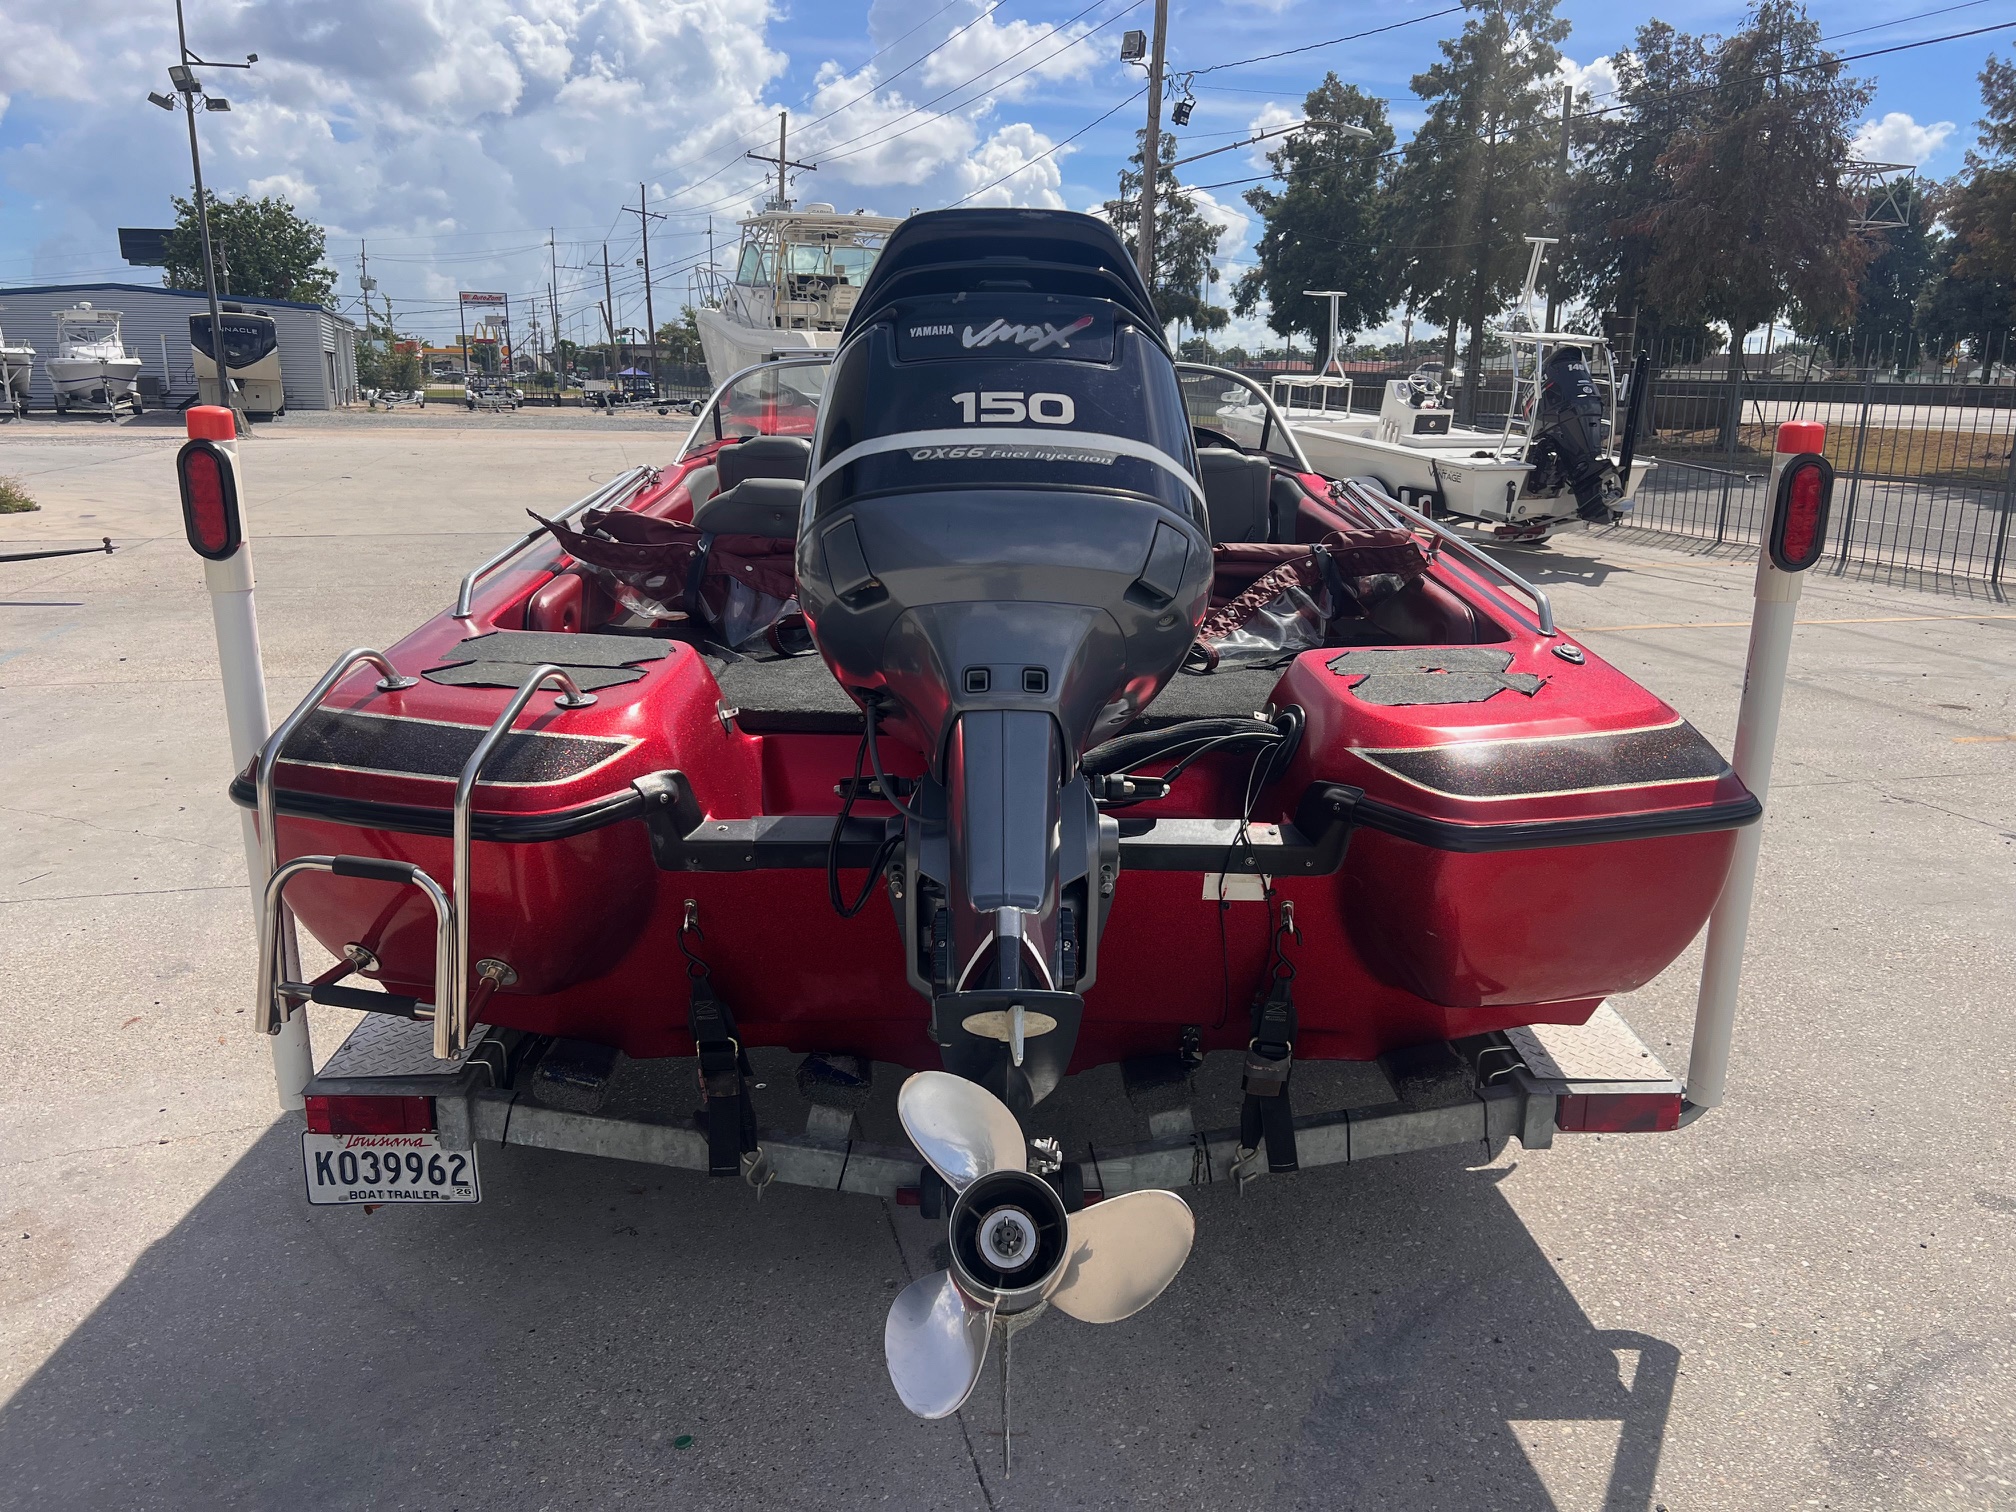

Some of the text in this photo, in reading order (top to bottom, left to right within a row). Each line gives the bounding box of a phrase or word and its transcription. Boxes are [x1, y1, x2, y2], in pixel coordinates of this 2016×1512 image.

[471, 294, 503, 302] AutoZone
[208, 326, 258, 335] PNNACLE
[909, 325, 954, 338] YAMAHA
[951, 391, 1075, 425] 150
[911, 448, 1113, 465] OX66 Fuel Injection
[345, 1134, 432, 1149] Louisiana
[315, 1150, 469, 1186] K039962
[350, 1190, 440, 1200] BOAT TRAILER
[456, 1188, 472, 1196] 26
